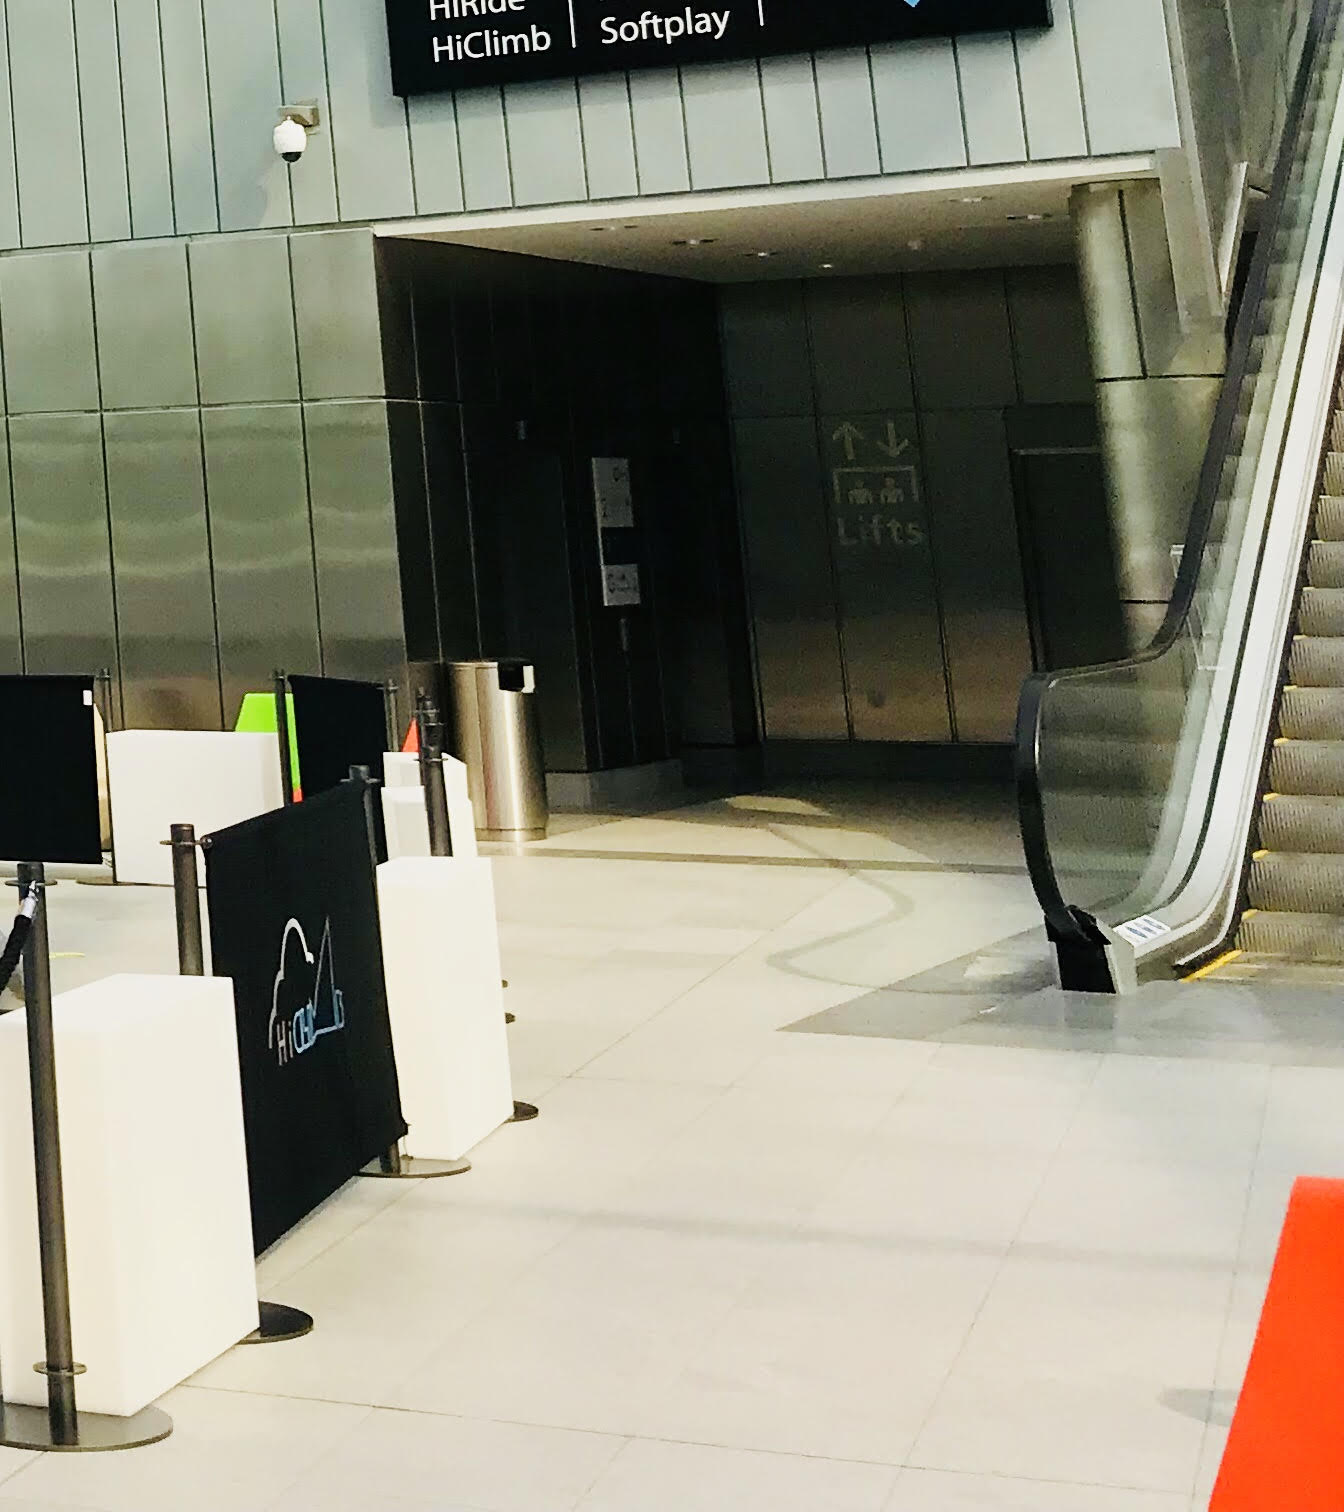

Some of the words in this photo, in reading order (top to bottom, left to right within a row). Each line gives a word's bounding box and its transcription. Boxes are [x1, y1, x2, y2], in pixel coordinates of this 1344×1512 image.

[431, 24, 552, 64] HiClimb
[600, 5, 730, 45] Softplay
[837, 514, 925, 546] Lifts
